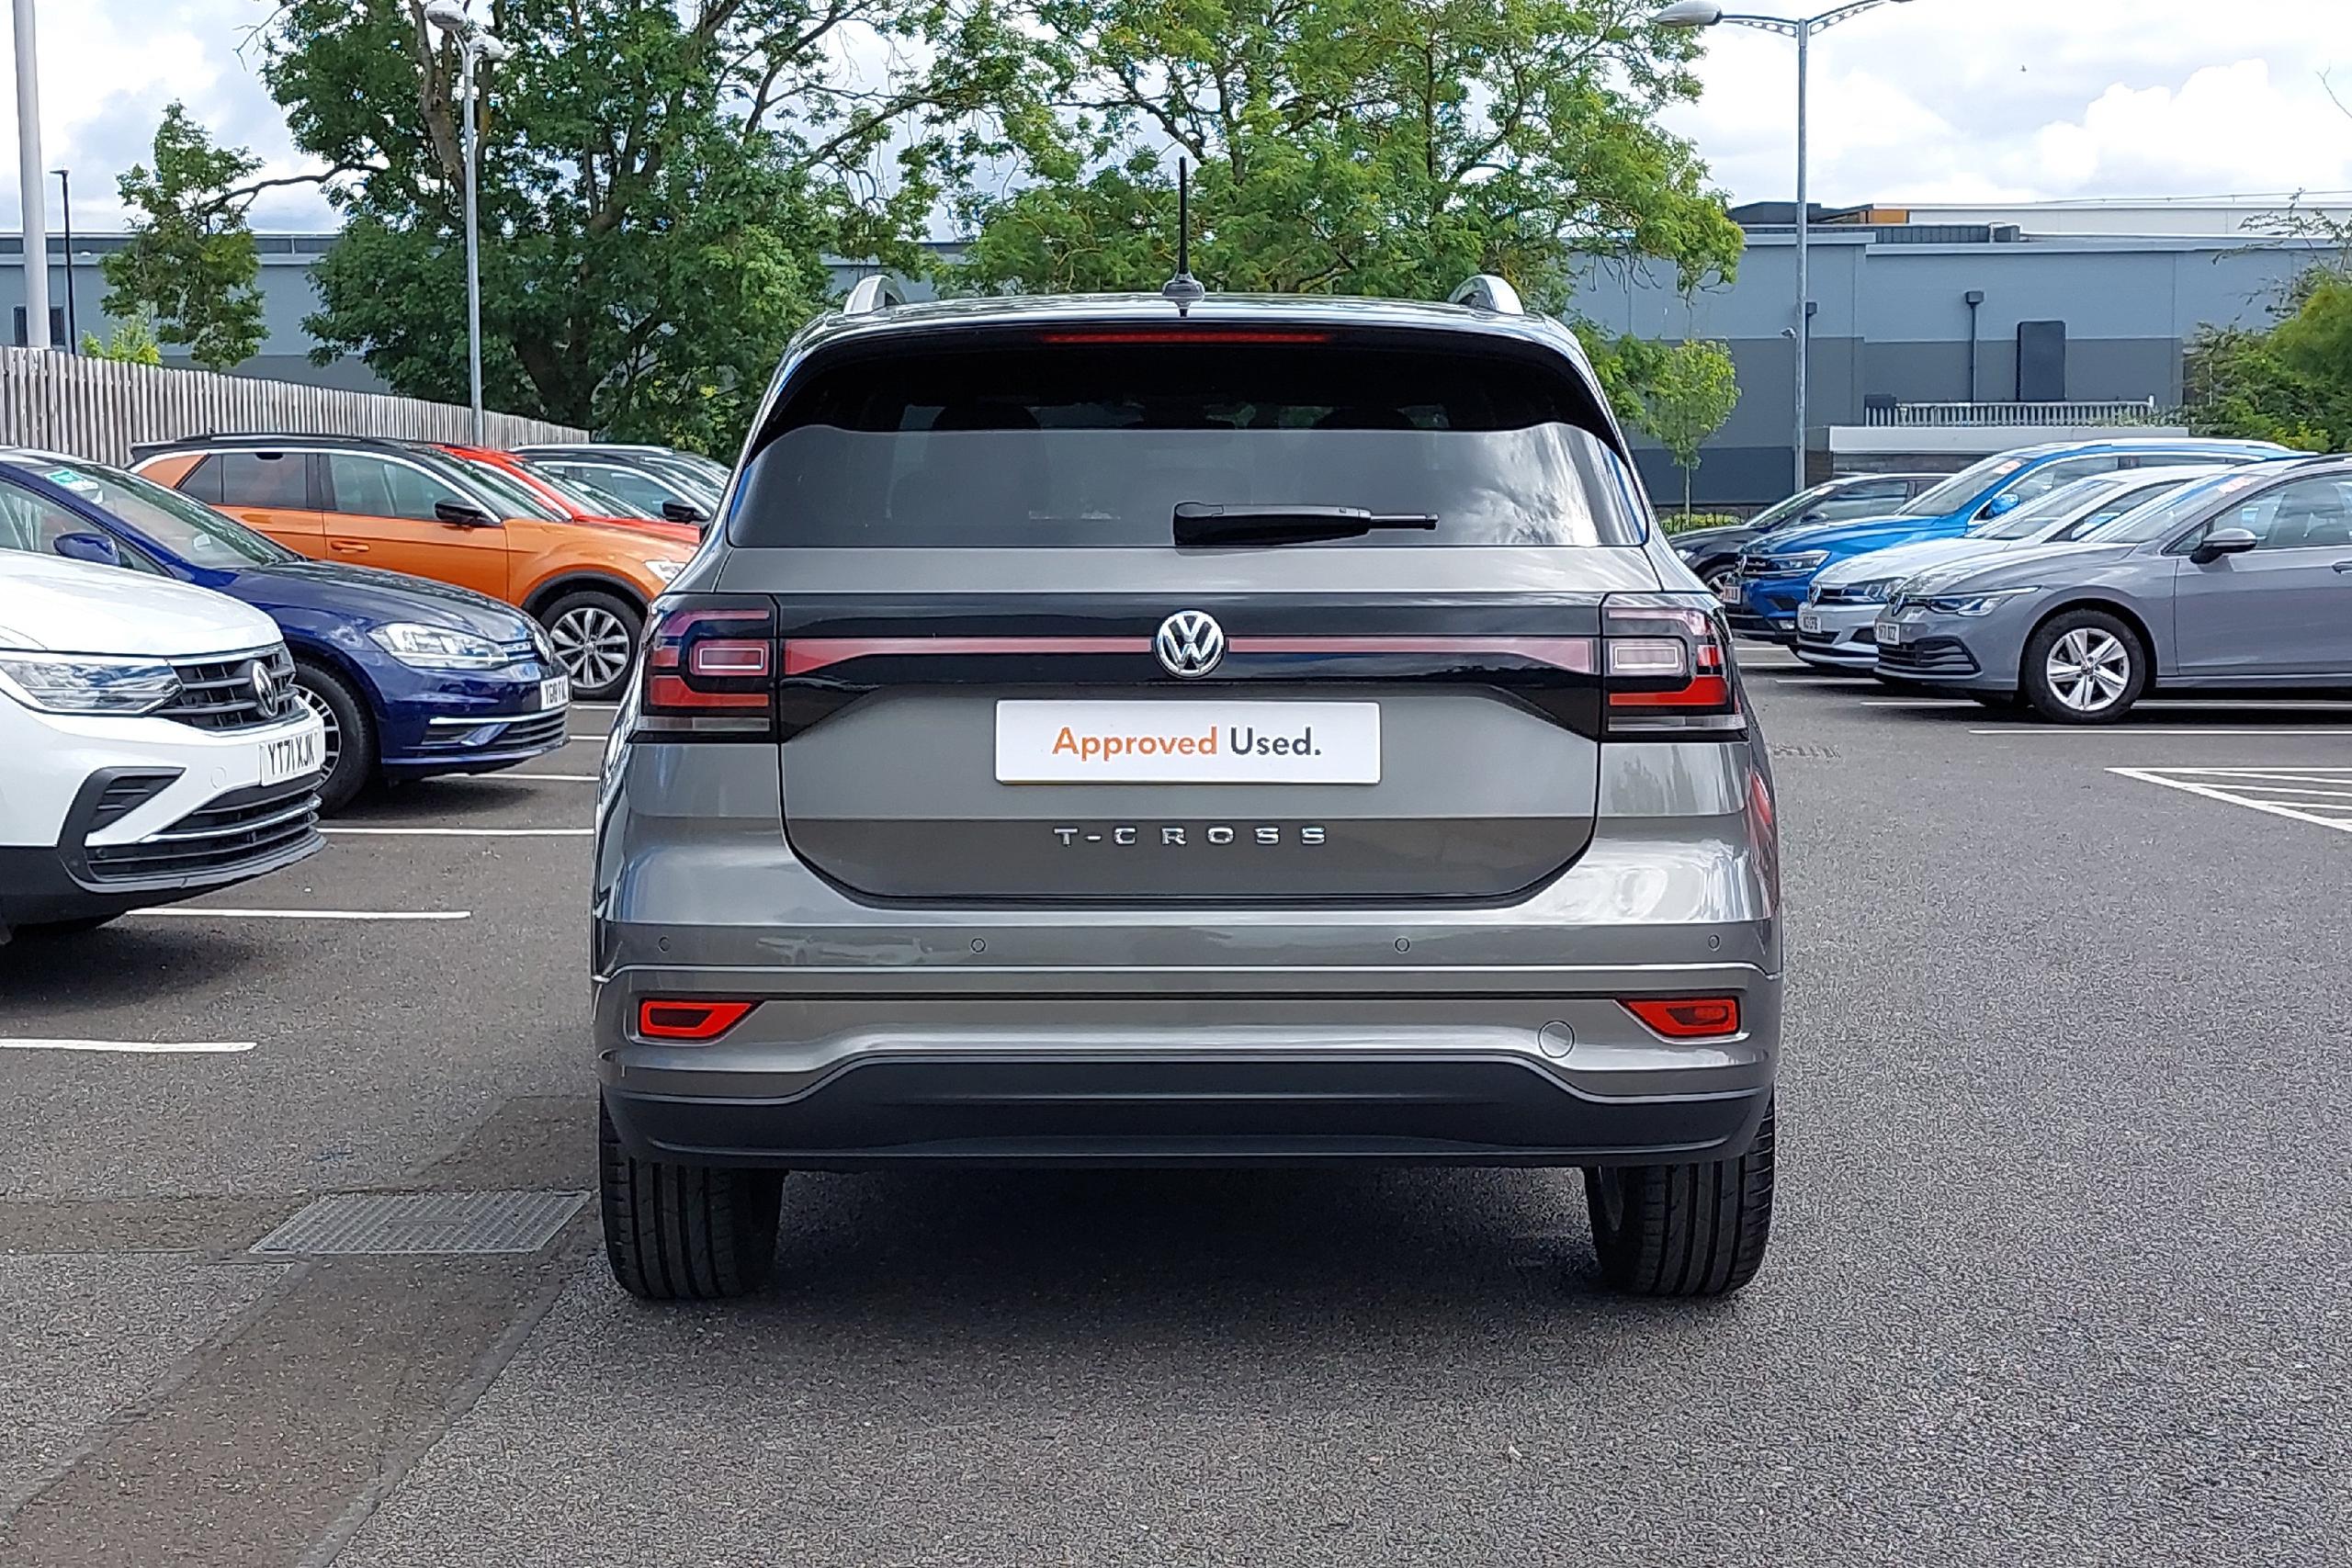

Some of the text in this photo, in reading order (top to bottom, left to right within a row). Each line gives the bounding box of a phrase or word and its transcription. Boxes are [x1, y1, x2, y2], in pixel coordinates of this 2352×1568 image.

[1052, 726, 1322, 761] Approved Used.
[1054, 827, 1326, 847] T-CROSS
